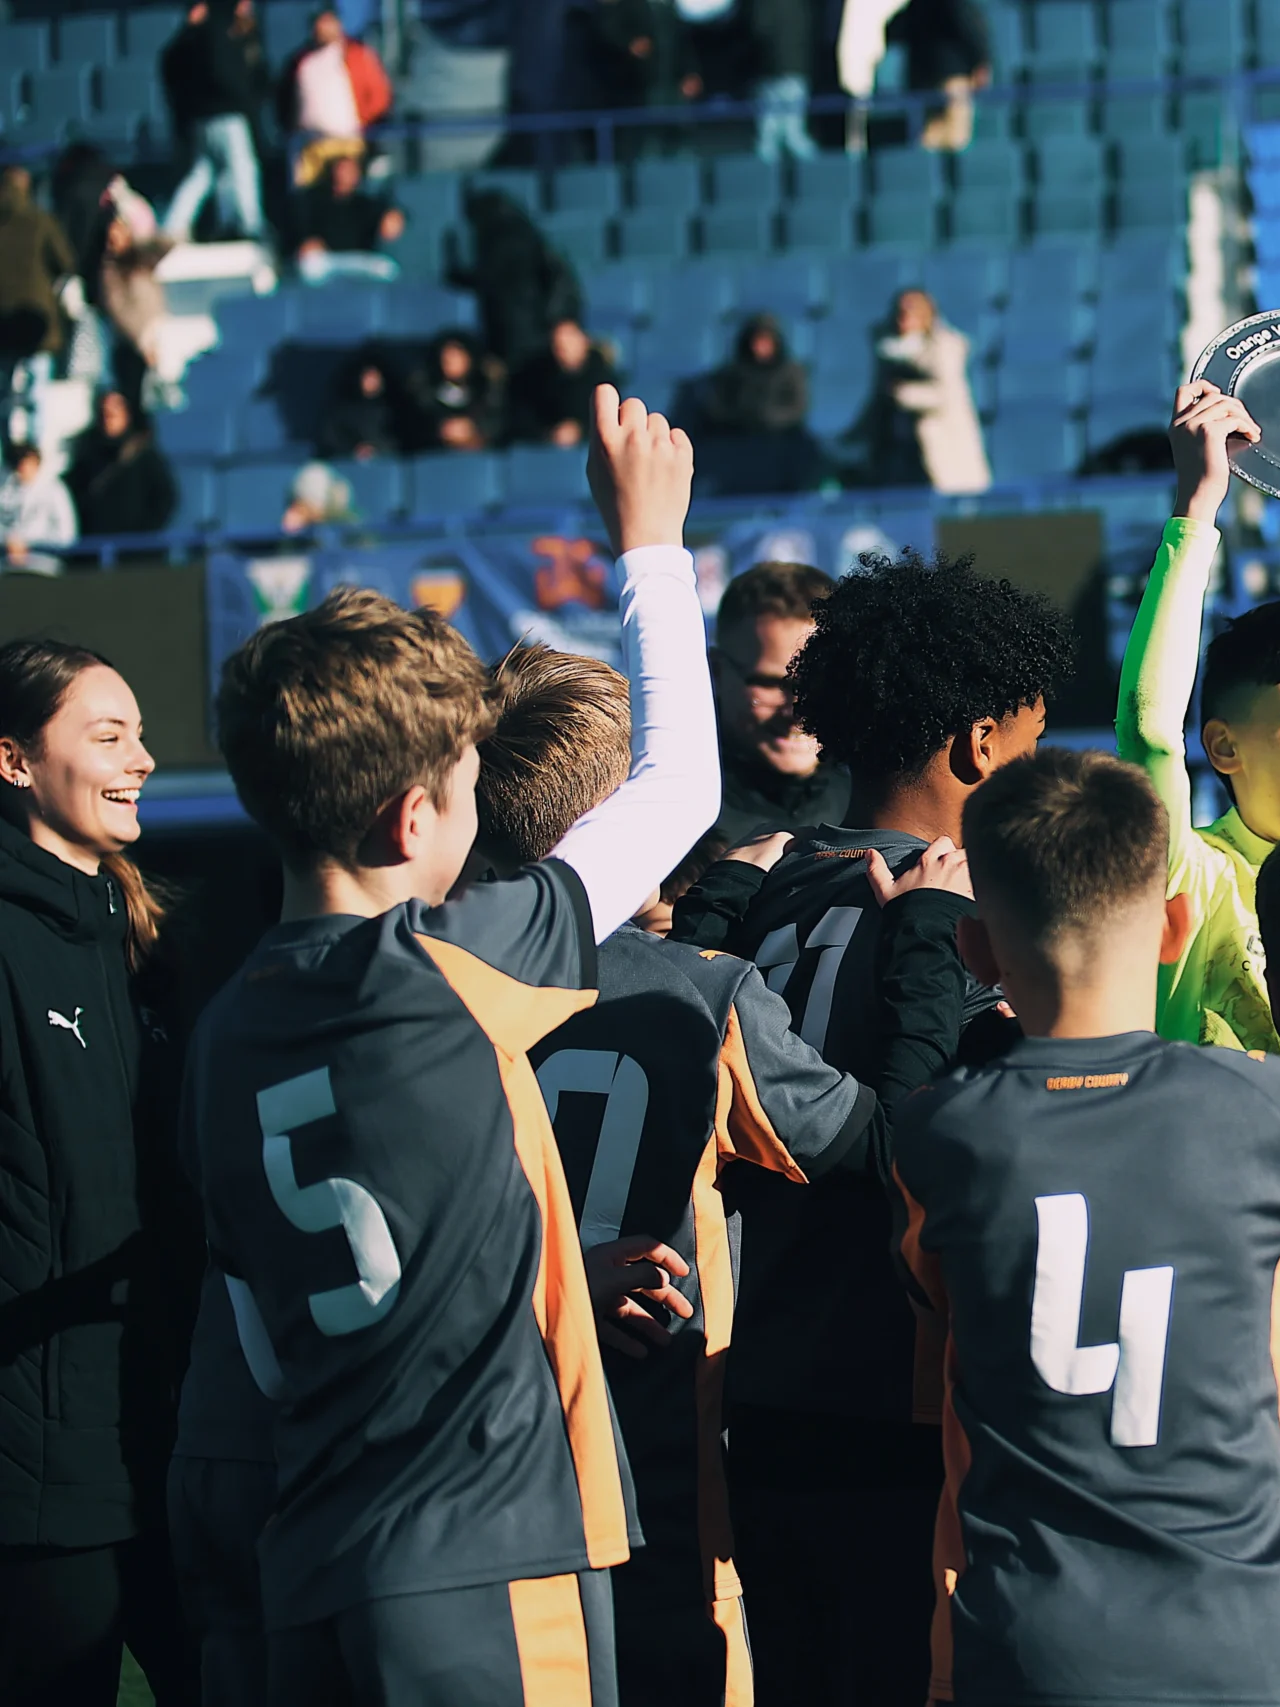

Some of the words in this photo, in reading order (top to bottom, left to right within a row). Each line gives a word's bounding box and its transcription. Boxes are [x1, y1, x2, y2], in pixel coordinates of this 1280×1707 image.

[1226, 329, 1272, 360] Orange
[256, 1065, 401, 1337] 5
[1029, 1192, 1175, 1447] 4
